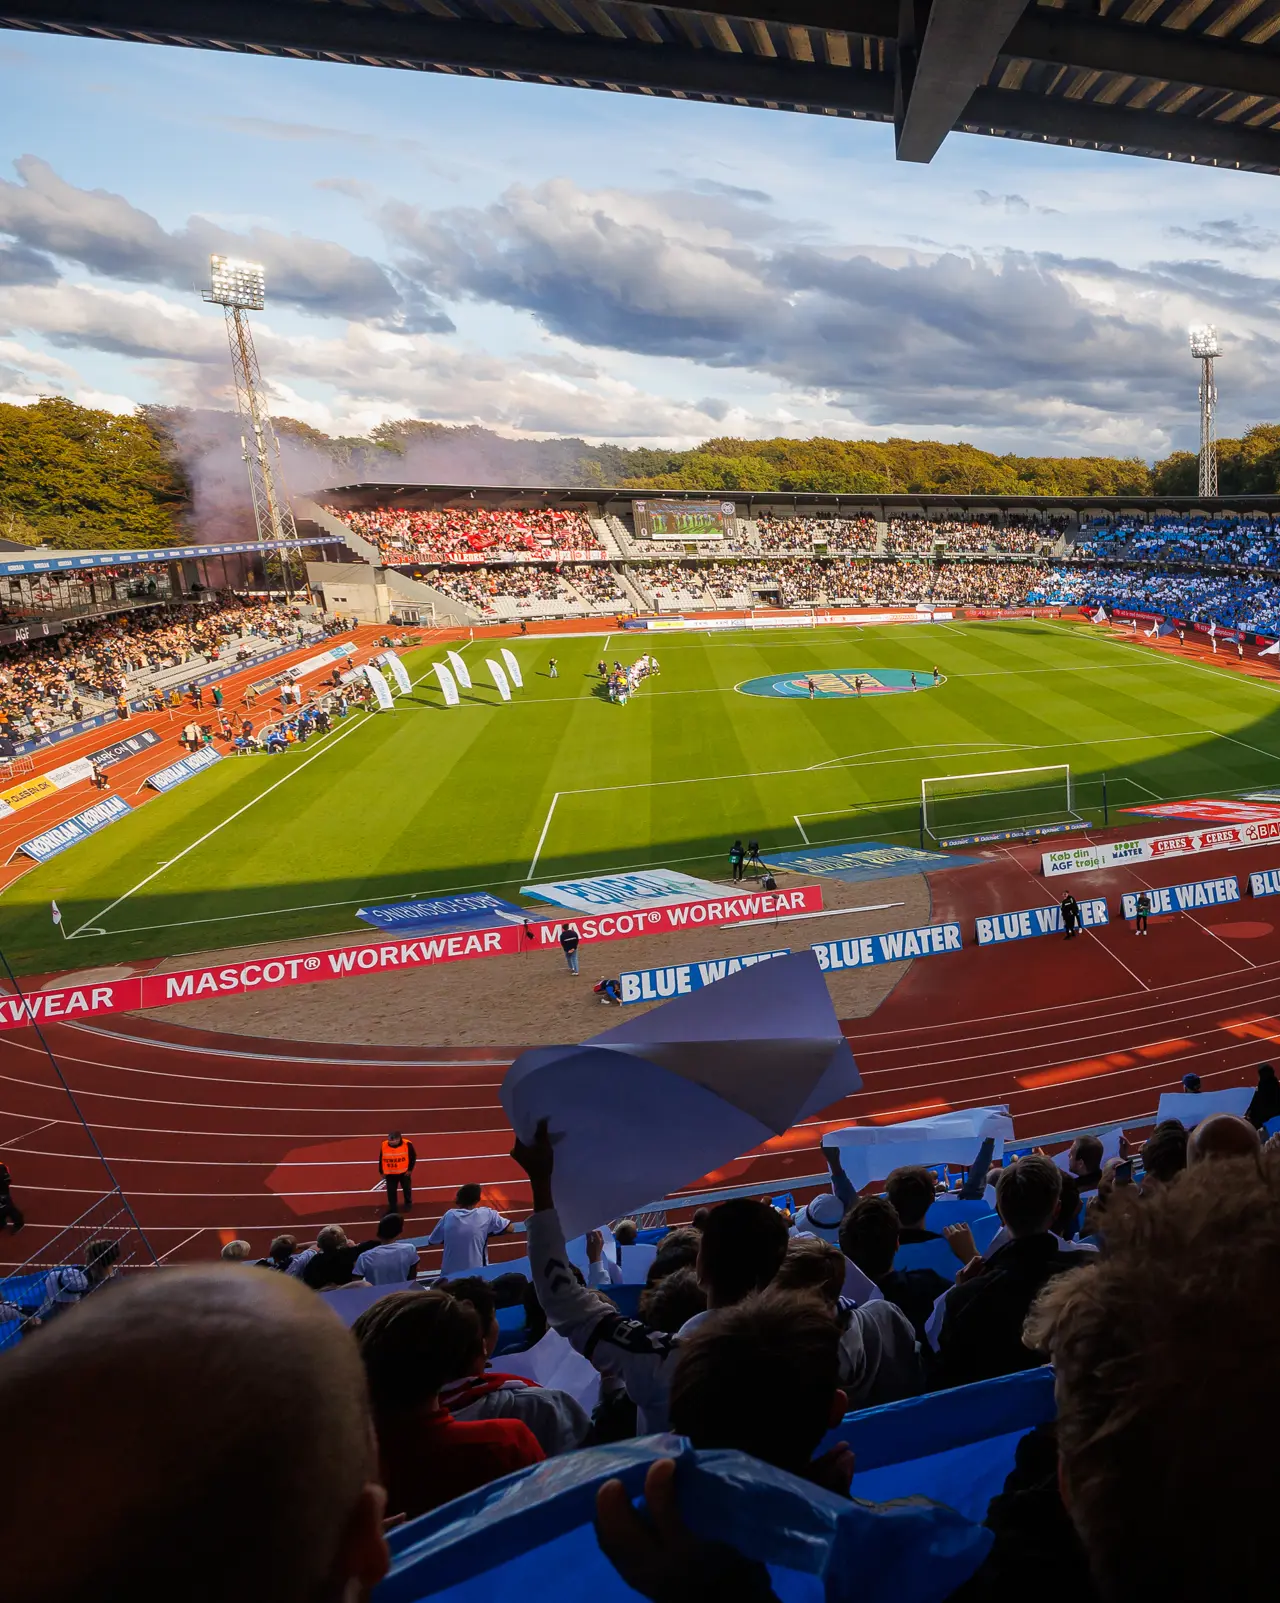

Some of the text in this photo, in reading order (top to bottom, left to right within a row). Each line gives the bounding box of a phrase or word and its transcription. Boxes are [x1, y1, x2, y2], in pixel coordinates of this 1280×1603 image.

[15, 628, 30, 641] AGF
[151, 761, 190, 788] HØRKRAM
[78, 796, 129, 829] HØRKRAM
[25, 821, 83, 857] HØRKRAM
[1114, 841, 1140, 851] SPORT
[1157, 838, 1187, 851] CERES
[1206, 830, 1234, 843] CERES
[1050, 849, 1089, 863] Køb din
[1051, 860, 1073, 872] AGF
[1075, 857, 1100, 869] trøje
[1112, 848, 1143, 859] MASTER
[373, 898, 461, 922] FORSIKRING
[667, 891, 805, 926] WORKWEAR
[1123, 878, 1240, 919] BUE WATER
[977, 901, 1107, 943] BLUE WER
[812, 926, 961, 971] BLUE WATER
[166, 932, 502, 999] MASCOT® WORKWEAR
[621, 972, 692, 1001] BLUE
